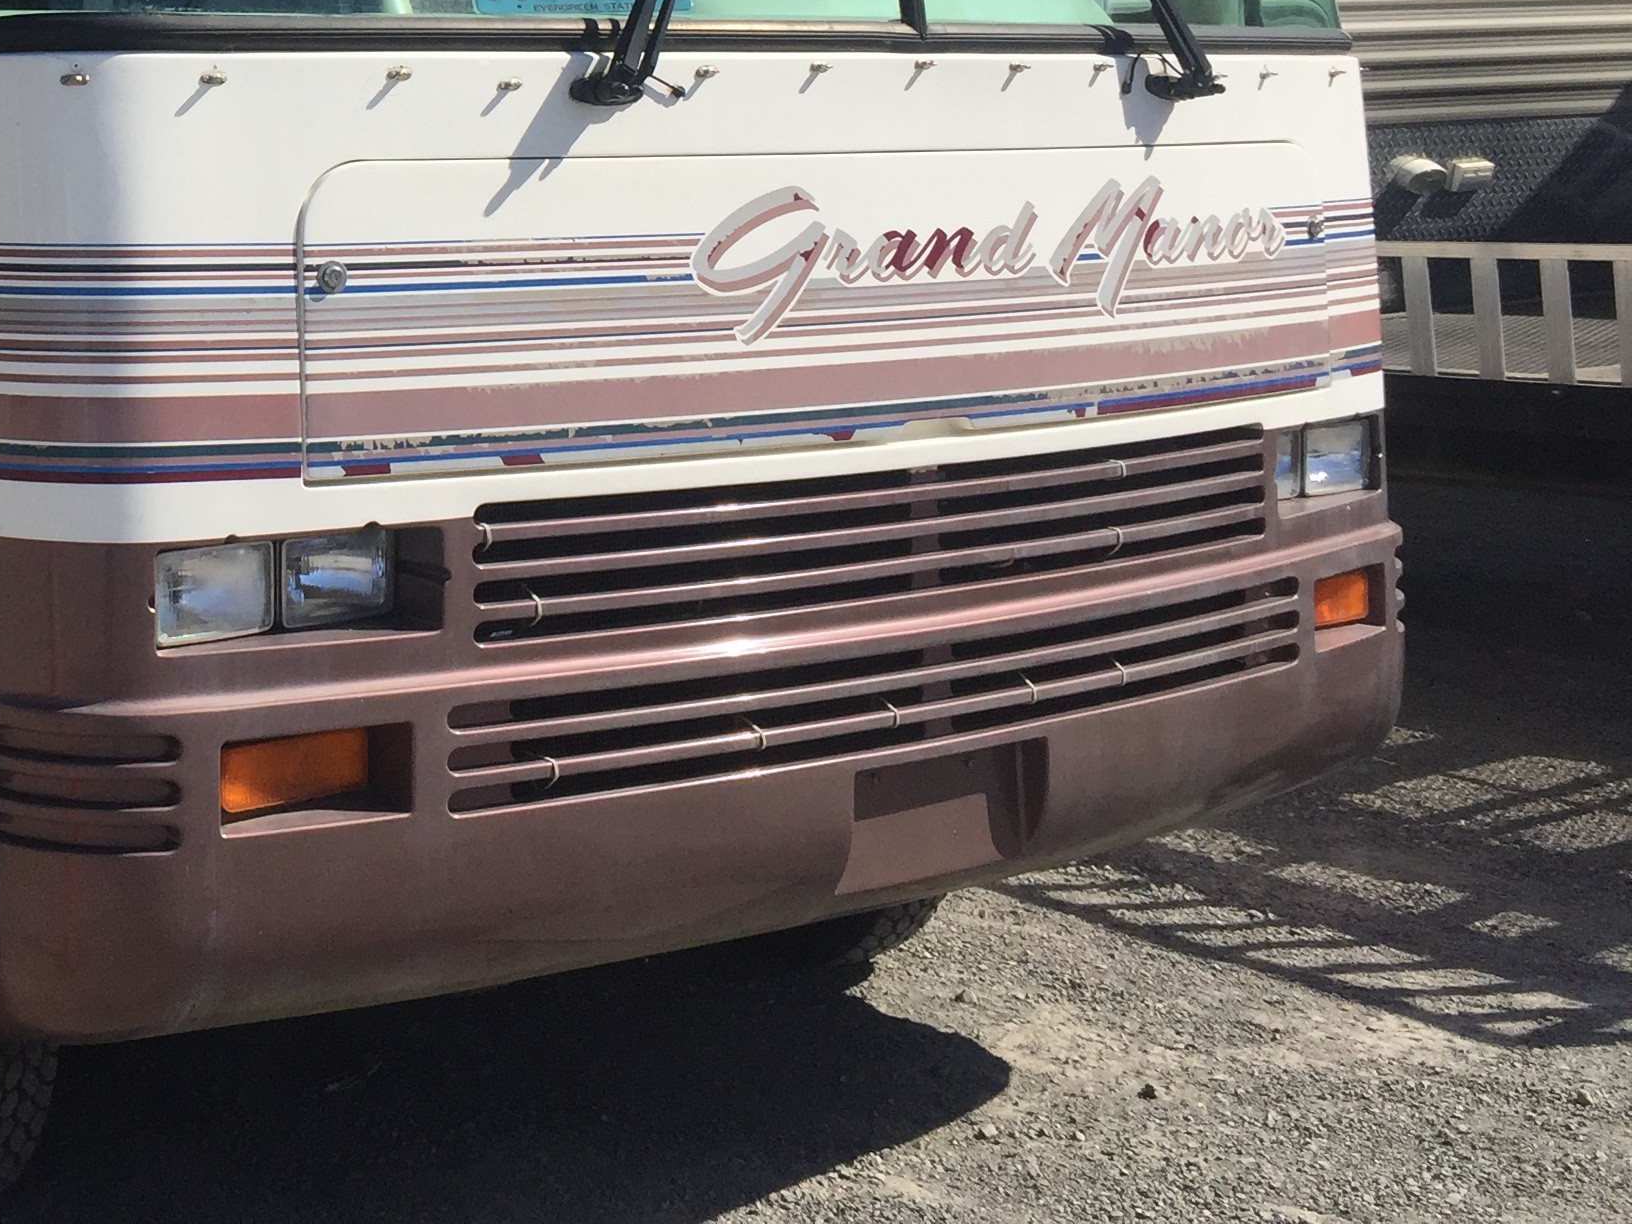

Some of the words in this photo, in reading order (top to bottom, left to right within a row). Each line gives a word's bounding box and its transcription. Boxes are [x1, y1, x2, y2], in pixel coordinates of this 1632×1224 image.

[533, 2, 599, 12] EVERGREEN
[603, 2, 632, 11] STAT
[690, 185, 1039, 347] Grand
[1046, 174, 1286, 319] Manor
